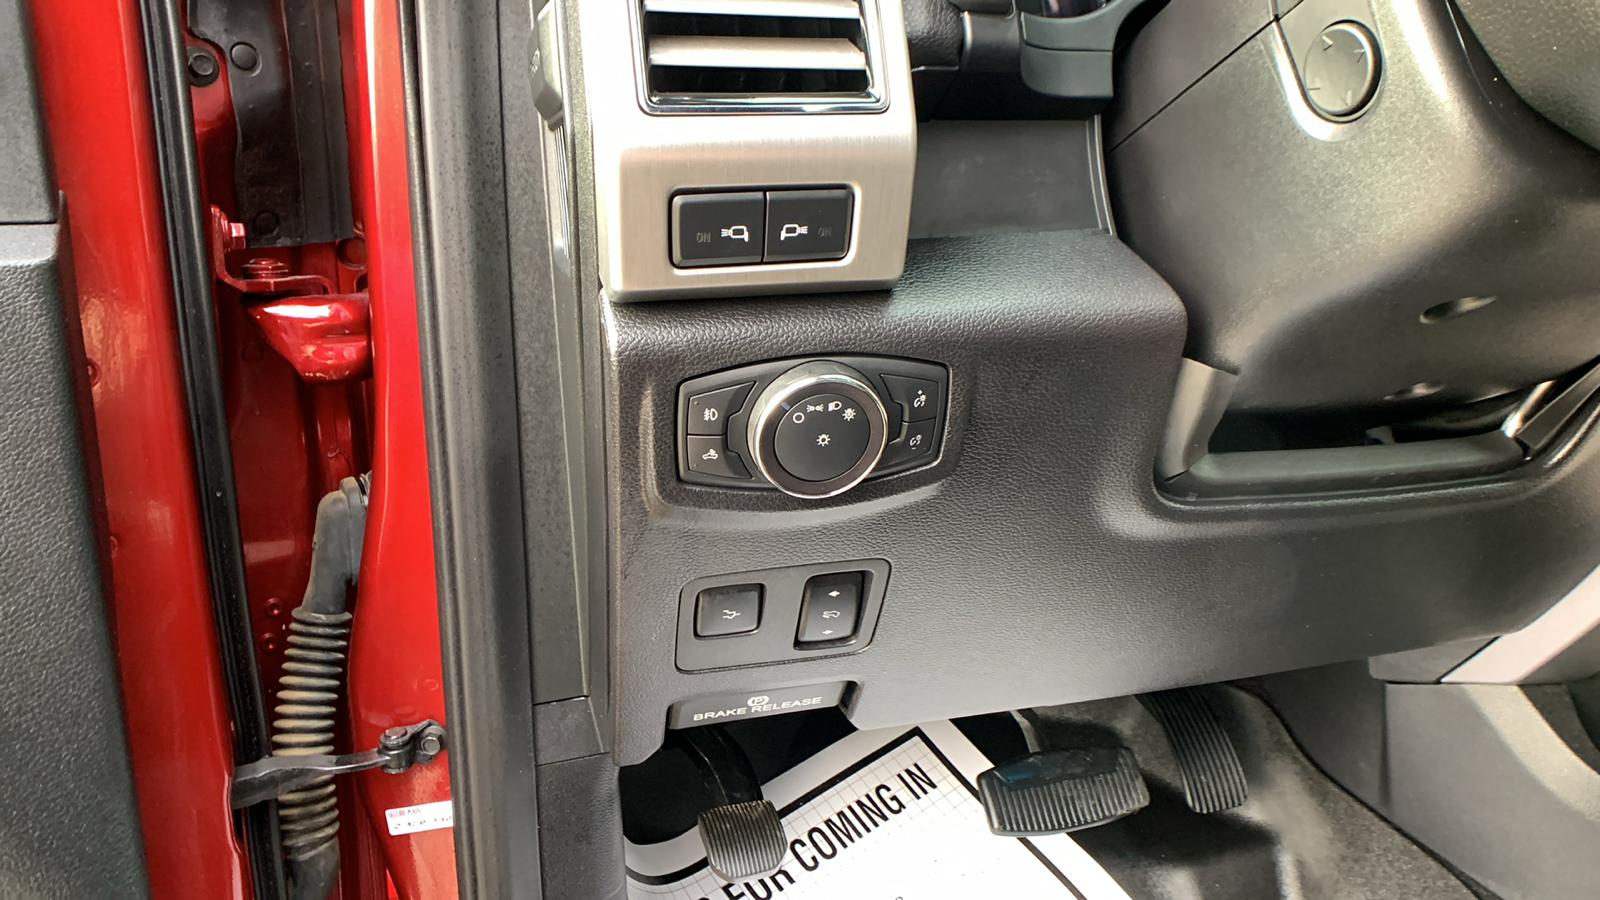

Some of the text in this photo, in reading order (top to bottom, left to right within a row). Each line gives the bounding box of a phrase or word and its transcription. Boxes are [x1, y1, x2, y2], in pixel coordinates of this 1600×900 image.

[696, 232, 711, 243] ON
[818, 226, 832, 238] ON
[693, 696, 823, 722] BRAKE RELEASE
[789, 783, 907, 872] COMING
[896, 762, 937, 800] IN
